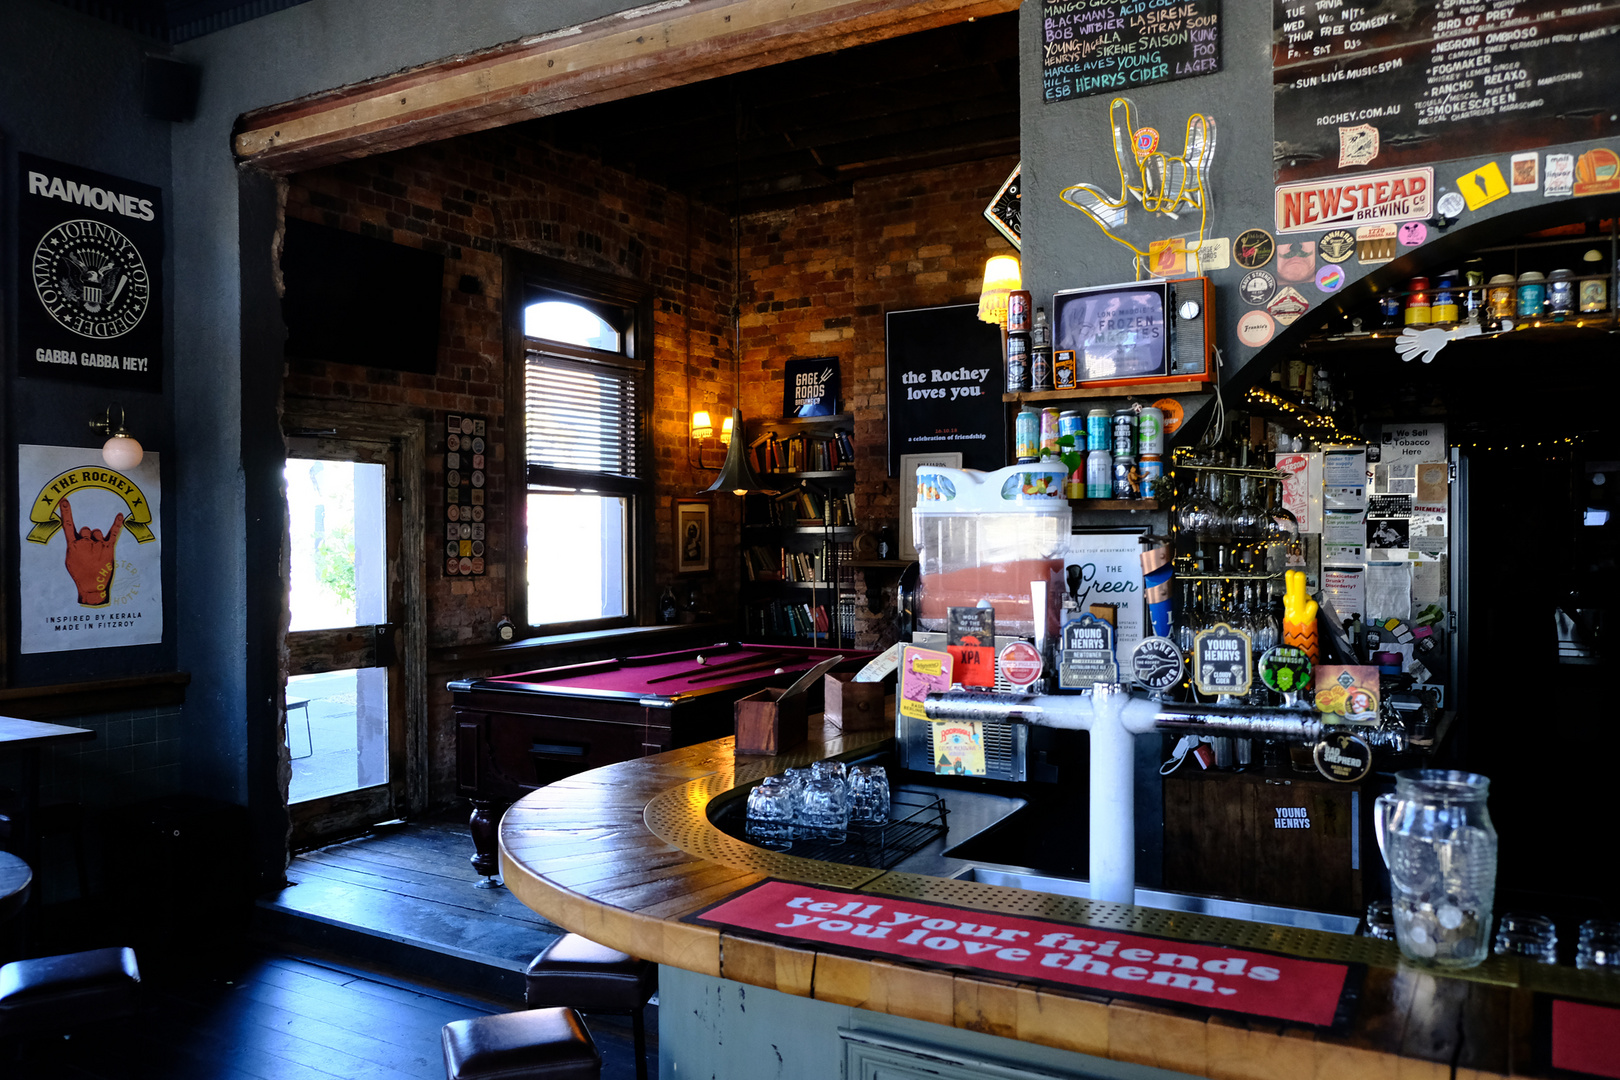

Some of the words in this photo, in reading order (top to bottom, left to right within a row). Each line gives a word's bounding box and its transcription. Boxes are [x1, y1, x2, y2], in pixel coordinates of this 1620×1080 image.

[1044, 2, 1086, 18] MANGO
[1120, 2, 1146, 16] ACID
[1286, 6, 1305, 18] TUE
[1044, 7, 1114, 30] BLACKMANS
[1186, 14, 1218, 28] SOUR
[1284, 20, 1305, 32] WED
[1437, 18, 1462, 32] BIRD
[1465, 15, 1480, 26] OF
[1486, 8, 1514, 22] PREY
[1046, 27, 1074, 42] BOB
[1104, 32, 1120, 44] LA
[1139, 30, 1188, 50] SAISON
[1190, 27, 1218, 42] KUNG
[1288, 30, 1314, 44] THUR
[1320, 24, 1345, 37] FREE
[1436, 36, 1480, 53] NEGRONI
[1486, 26, 1538, 44] OMBROSO
[1044, 39, 1082, 58] YOUNG
[1096, 42, 1137, 58] SIRENE
[1193, 44, 1216, 58] FOO
[1313, 44, 1331, 56] SAT
[1045, 51, 1081, 66] HENRYS
[1118, 51, 1162, 71] YOUNG
[1176, 58, 1217, 74] LAGER
[1432, 54, 1492, 76] FOGMAKER
[1076, 72, 1126, 92] HENRYS
[1130, 63, 1168, 82] CIDER
[1296, 76, 1317, 88] SUN
[1322, 70, 1345, 82] LIVE
[1346, 65, 1378, 80] MUSIC
[1378, 57, 1403, 73] 5PM
[1044, 76, 1071, 88] HILL
[1431, 80, 1474, 97] RANCHO
[1484, 69, 1527, 86] RELAXO
[1046, 85, 1071, 99] ESB
[1426, 92, 1517, 116] SMOKESCREEN
[1316, 104, 1400, 126] ROCHEY.COM.AU
[29, 171, 154, 221] RAMONES
[1283, 177, 1426, 229] NEWSTEAD
[1357, 199, 1410, 220] BREWING
[58, 222, 130, 253] JOHNNY
[35, 242, 65, 318] TOMMY
[129, 261, 147, 306] JOEY
[1099, 316, 1154, 330] FROZEN
[36, 348, 77, 365] GABBA
[81, 352, 119, 369] GABBA
[123, 356, 148, 372] HEY!
[796, 372, 818, 386] GAGE
[902, 371, 926, 385] the
[931, 367, 990, 383] Rochey
[795, 384, 825, 398] ROADS
[907, 387, 946, 400] loves
[51, 474, 78, 494] THE
[83, 472, 134, 495] ROCHEY
[96, 560, 138, 599] ROCHESTER
[114, 583, 140, 606] HOTEL
[46, 615, 90, 623] INSPIRED
[110, 612, 142, 620] KERALA
[1073, 628, 1102, 639] YOUNG
[1071, 639, 1104, 649] HENRYS
[1140, 642, 1176, 658] ROCHEY
[1207, 639, 1238, 650] YOUNG
[961, 651, 980, 664] XPA
[1204, 650, 1240, 661] HENRYS
[1150, 668, 1178, 687] LAGER
[1324, 753, 1362, 768] SHEPHERD
[1275, 807, 1307, 818] YOUNG
[1274, 818, 1310, 829] HENRYS
[775, 914, 892, 938] you
[897, 928, 1032, 962] love
[786, 897, 883, 919] tell
[879, 912, 1030, 941] your
[1035, 932, 1281, 982] friends
